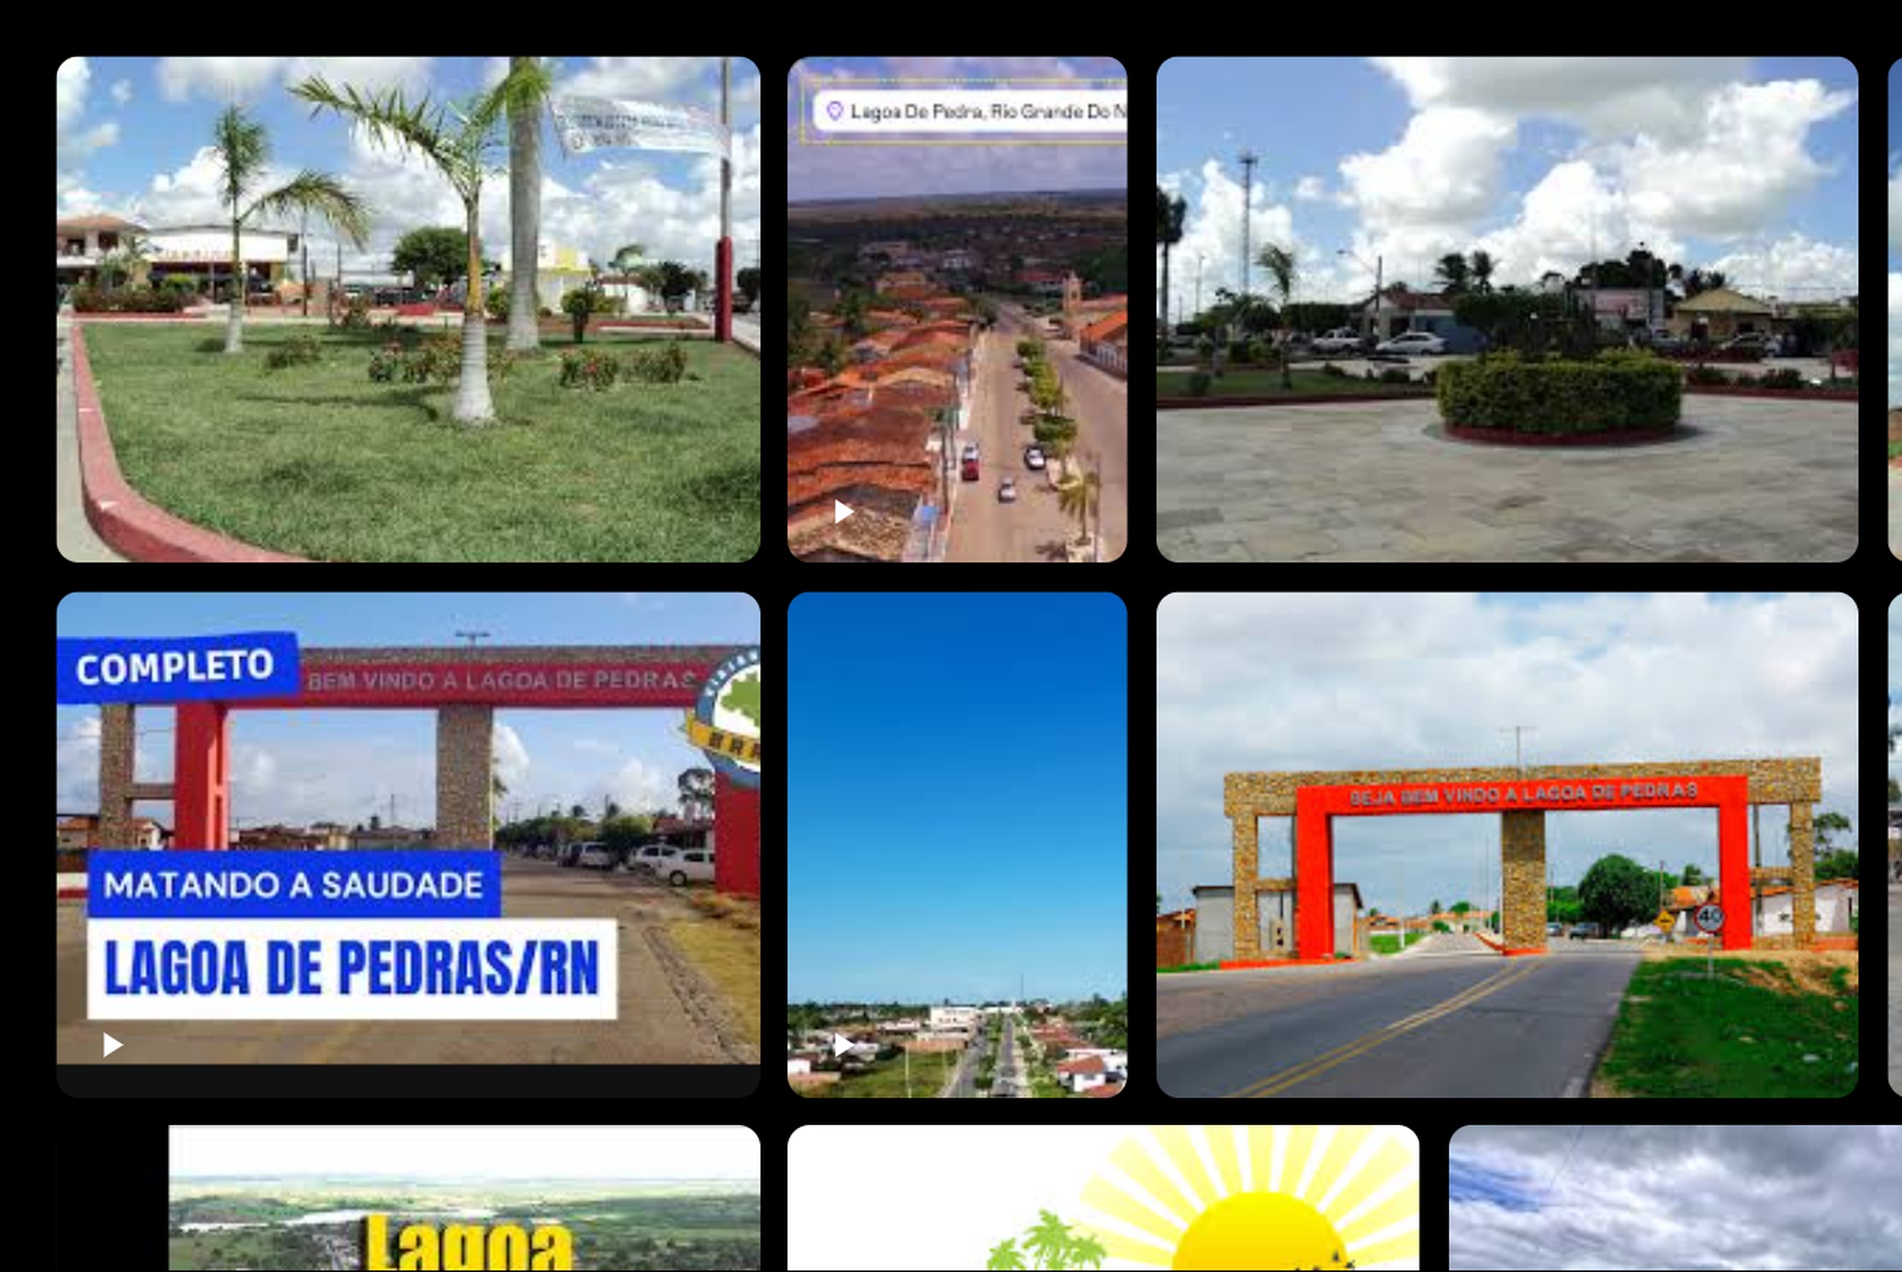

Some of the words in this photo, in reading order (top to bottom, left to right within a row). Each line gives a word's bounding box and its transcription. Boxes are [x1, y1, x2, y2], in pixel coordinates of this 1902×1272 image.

[308, 672, 356, 691] BEM
[362, 671, 434, 691] VINDO
[443, 672, 458, 689] A
[466, 671, 547, 690] LAGOA
[556, 670, 587, 689] DE
[594, 670, 697, 689] PEDRAS
[1350, 791, 1395, 806] SEJA
[1401, 789, 1438, 804] BEM
[1443, 787, 1499, 803] VINDO
[1506, 786, 1517, 802] A
[1523, 784, 1585, 801] LAGOA
[1592, 784, 1615, 800] DE
[1620, 782, 1697, 799] PEDRAS
